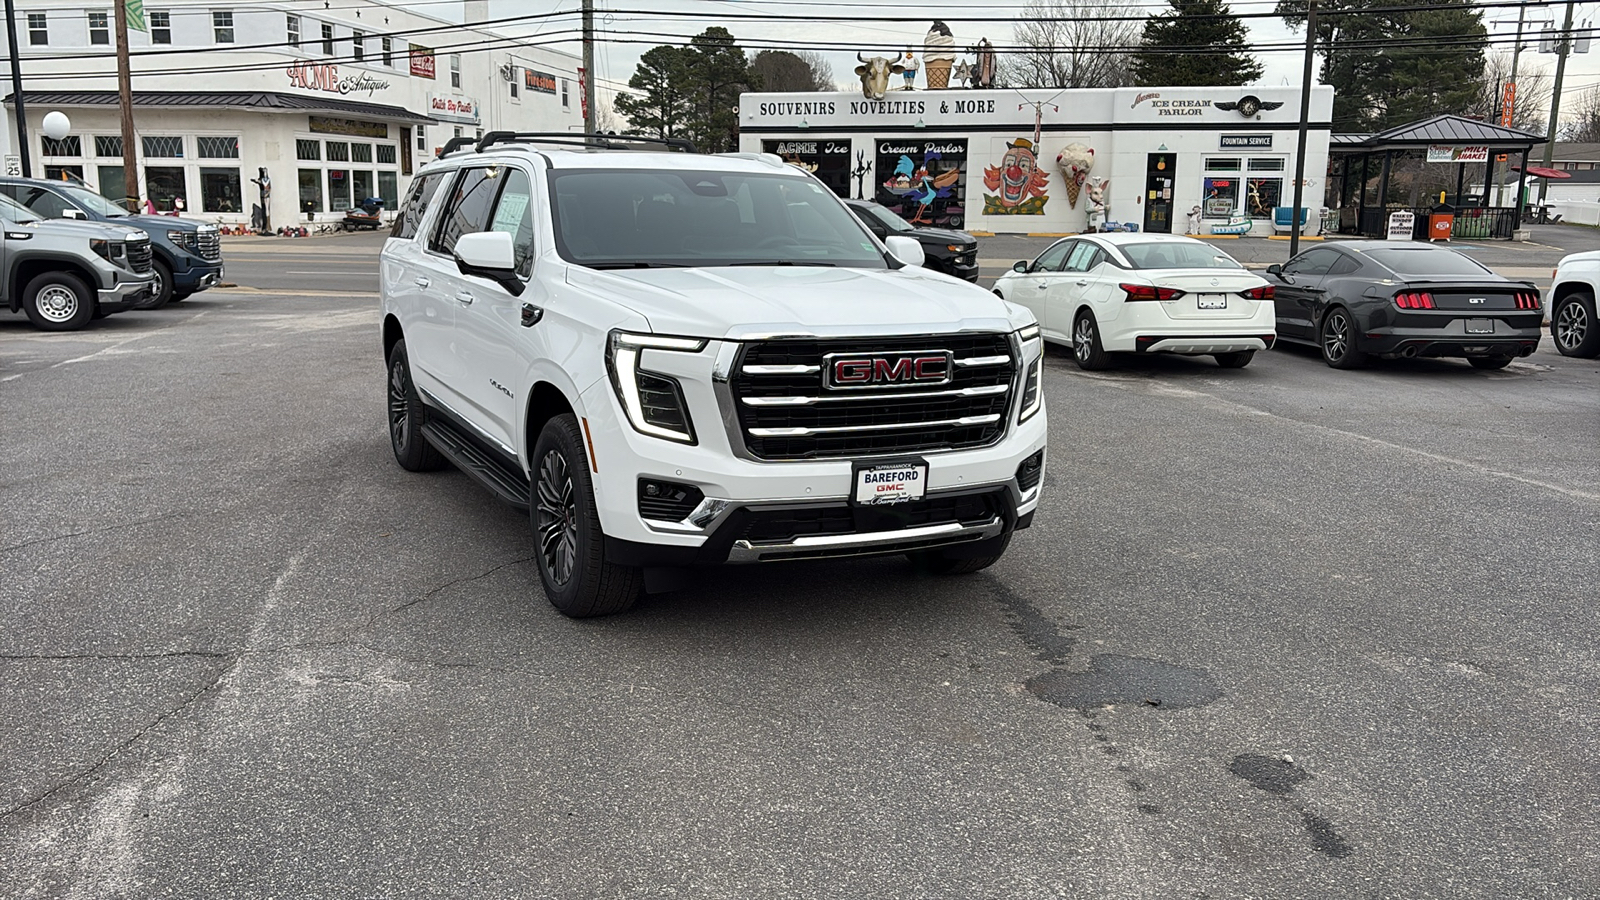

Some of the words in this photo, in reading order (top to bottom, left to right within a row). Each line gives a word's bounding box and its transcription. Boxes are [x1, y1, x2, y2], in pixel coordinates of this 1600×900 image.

[287, 59, 339, 93] ACME
[339, 71, 390, 97] Antiques
[525, 70, 556, 91] Firestone
[432, 98, 445, 110] Dutch
[447, 99, 457, 114] Boy
[760, 102, 836, 116] SOUVENIRS
[850, 101, 926, 115] NOVELTIES
[939, 101, 950, 114] &
[954, 100, 996, 114] MORE
[1151, 100, 1169, 108] ICE
[1172, 99, 1212, 108] CREAM
[1158, 108, 1203, 116] PARLOR
[879, 142, 919, 154] Cream
[924, 141, 966, 154] Parlor
[1222, 137, 1248, 146] FOUNTAIN
[1249, 137, 1271, 146] SERVICE
[776, 142, 818, 154] ACME
[824, 142, 849, 154] Ice
[8, 166, 20, 176] 25
[835, 356, 947, 383] GMC
[864, 471, 918, 484] BAREFORD
[876, 483, 904, 492] GMC
[870, 494, 911, 506] Bareford
